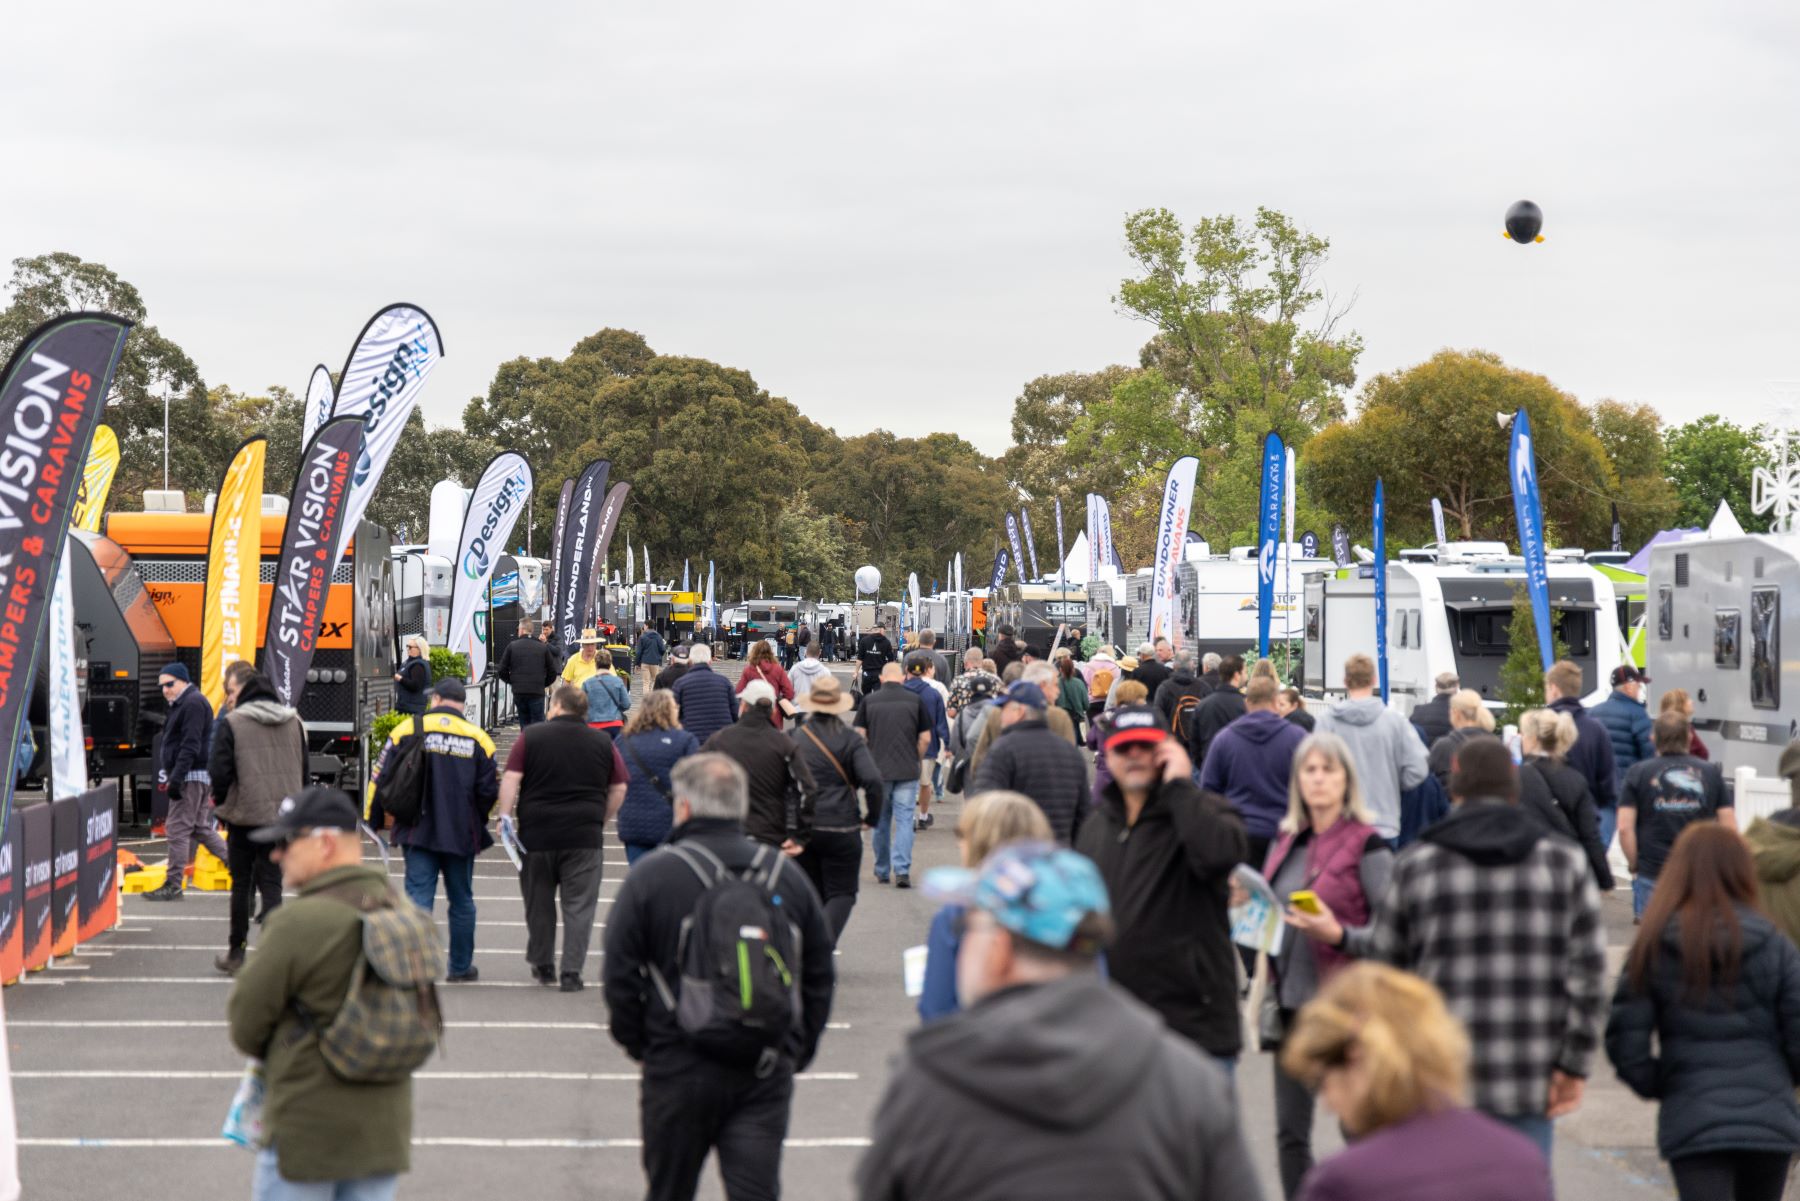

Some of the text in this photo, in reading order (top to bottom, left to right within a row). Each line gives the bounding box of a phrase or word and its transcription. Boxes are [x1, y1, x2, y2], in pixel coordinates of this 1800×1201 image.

[360, 343, 413, 456] esign
[31, 369, 92, 526] CARAVANS
[1269, 454, 1280, 532] CARAVANS
[294, 442, 339, 549] VISION
[320, 451, 350, 542] CARAVANS
[469, 477, 516, 560] Design
[1157, 479, 1180, 598] SUNDOWNER
[22, 535, 45, 557] &
[315, 548, 328, 561] &
[565, 488, 592, 620] WONDERLAND
[279, 556, 312, 647] STAR
[301, 566, 325, 652] CAMPERS
